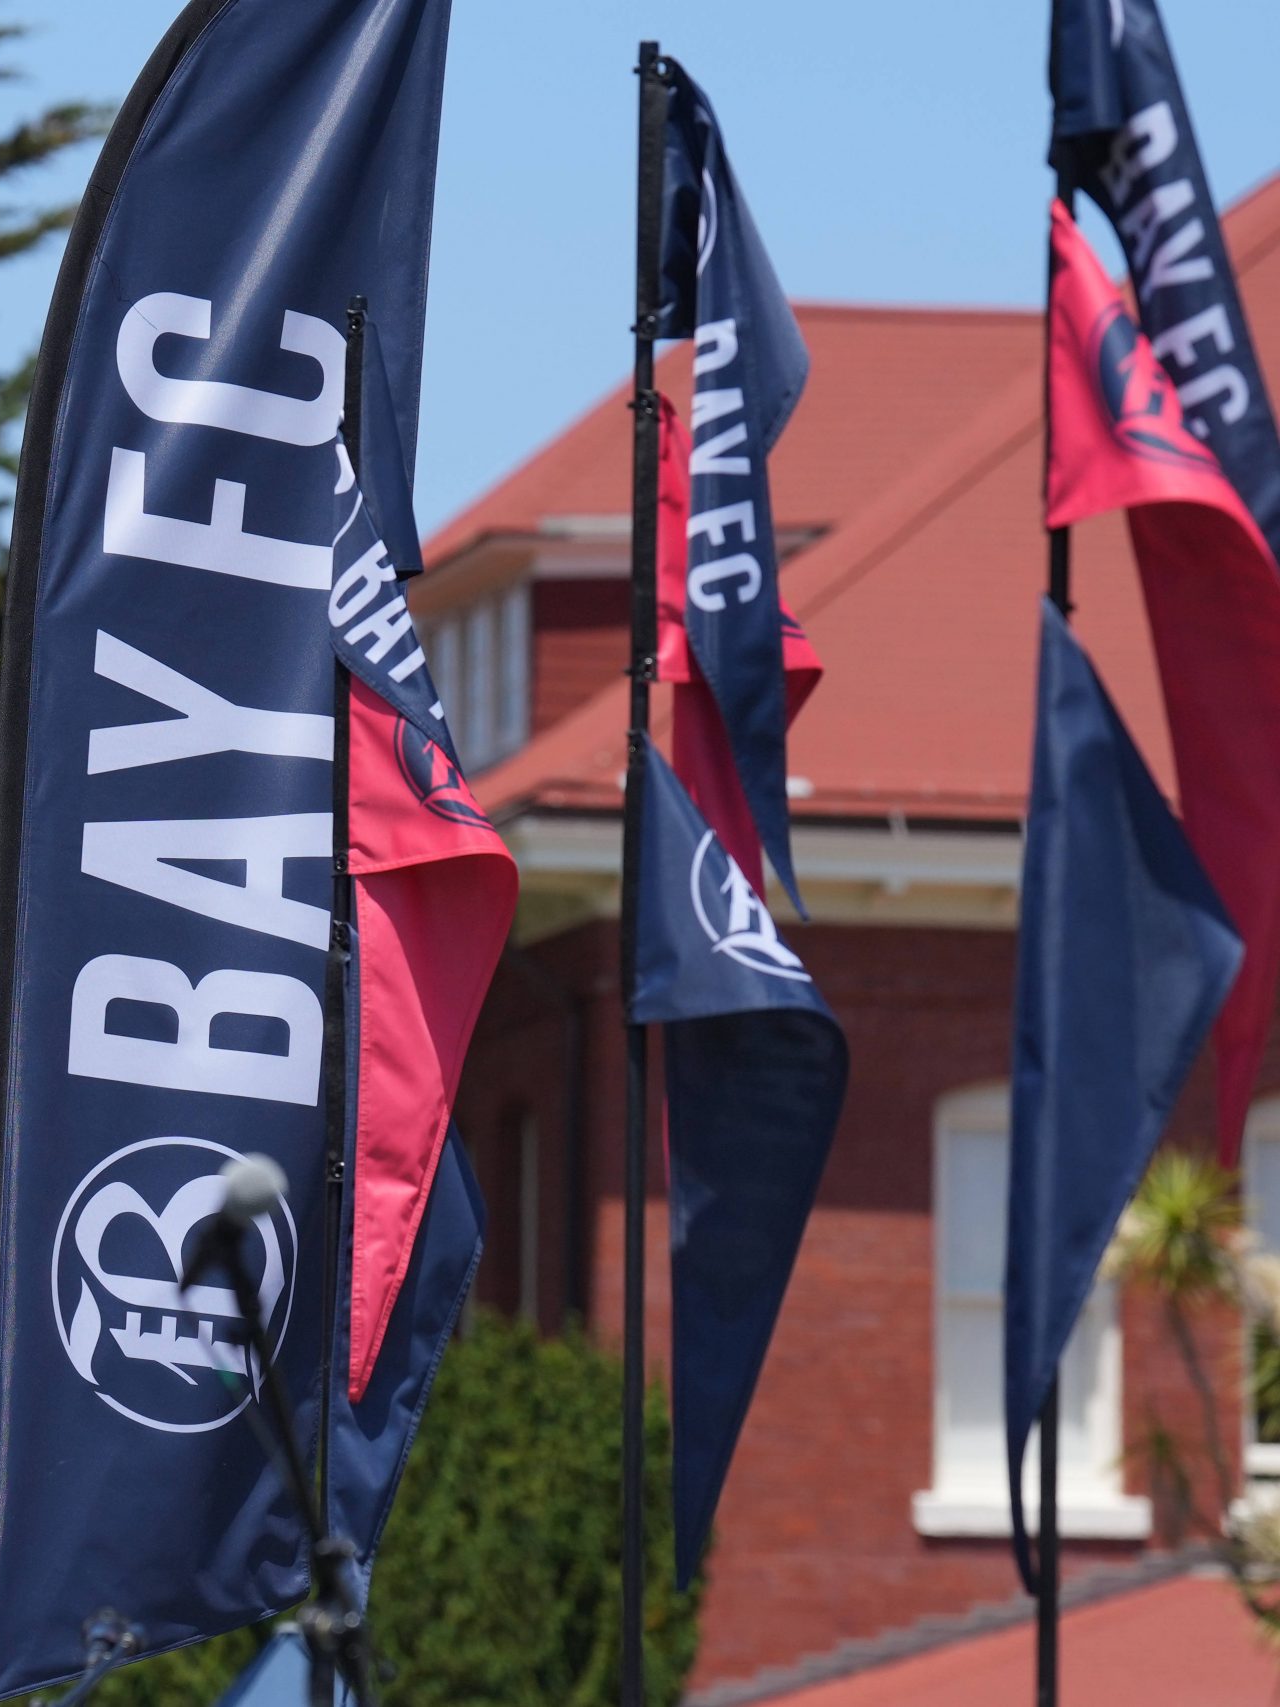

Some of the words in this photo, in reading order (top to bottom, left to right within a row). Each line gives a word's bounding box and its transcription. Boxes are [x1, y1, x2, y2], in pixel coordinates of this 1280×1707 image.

[103, 292, 347, 590] FC
[686, 499, 762, 613] FC
[69, 629, 334, 1107] BAY
